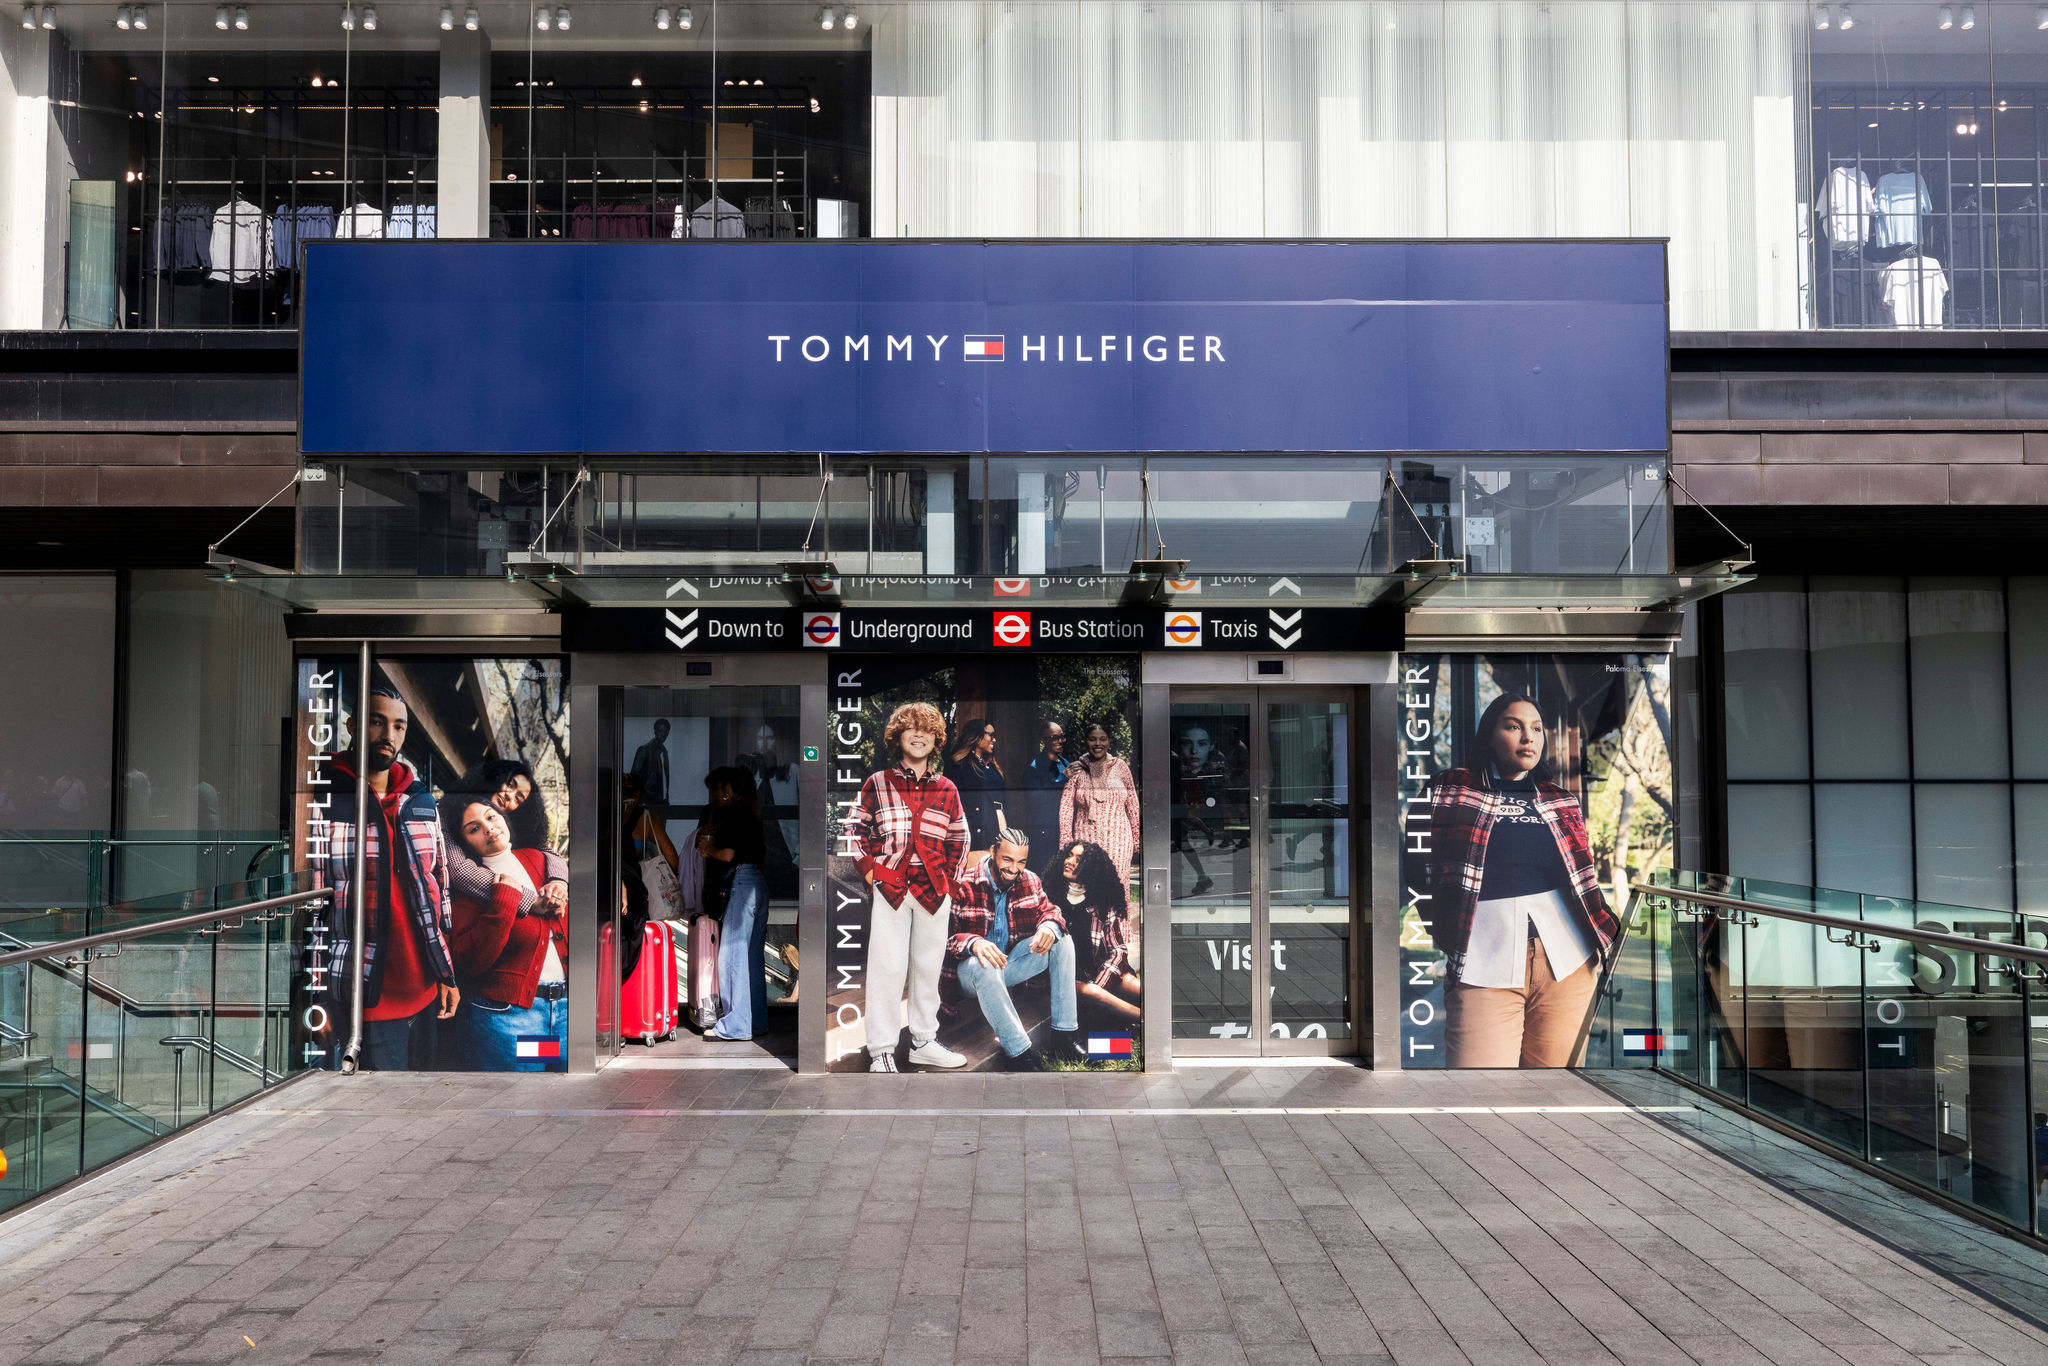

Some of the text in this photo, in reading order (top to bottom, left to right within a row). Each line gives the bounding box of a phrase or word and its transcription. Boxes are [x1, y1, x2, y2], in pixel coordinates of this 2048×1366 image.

[768, 335, 1226, 362] TOMMY HILFIGER
[708, 619, 1258, 642] Down to Underground Bus Station Taxis
[305, 669, 334, 859] HILFIGER
[836, 668, 862, 1062] TOMMY HILFIGER
[1405, 664, 1435, 1058] TOMMY HILFIGER
